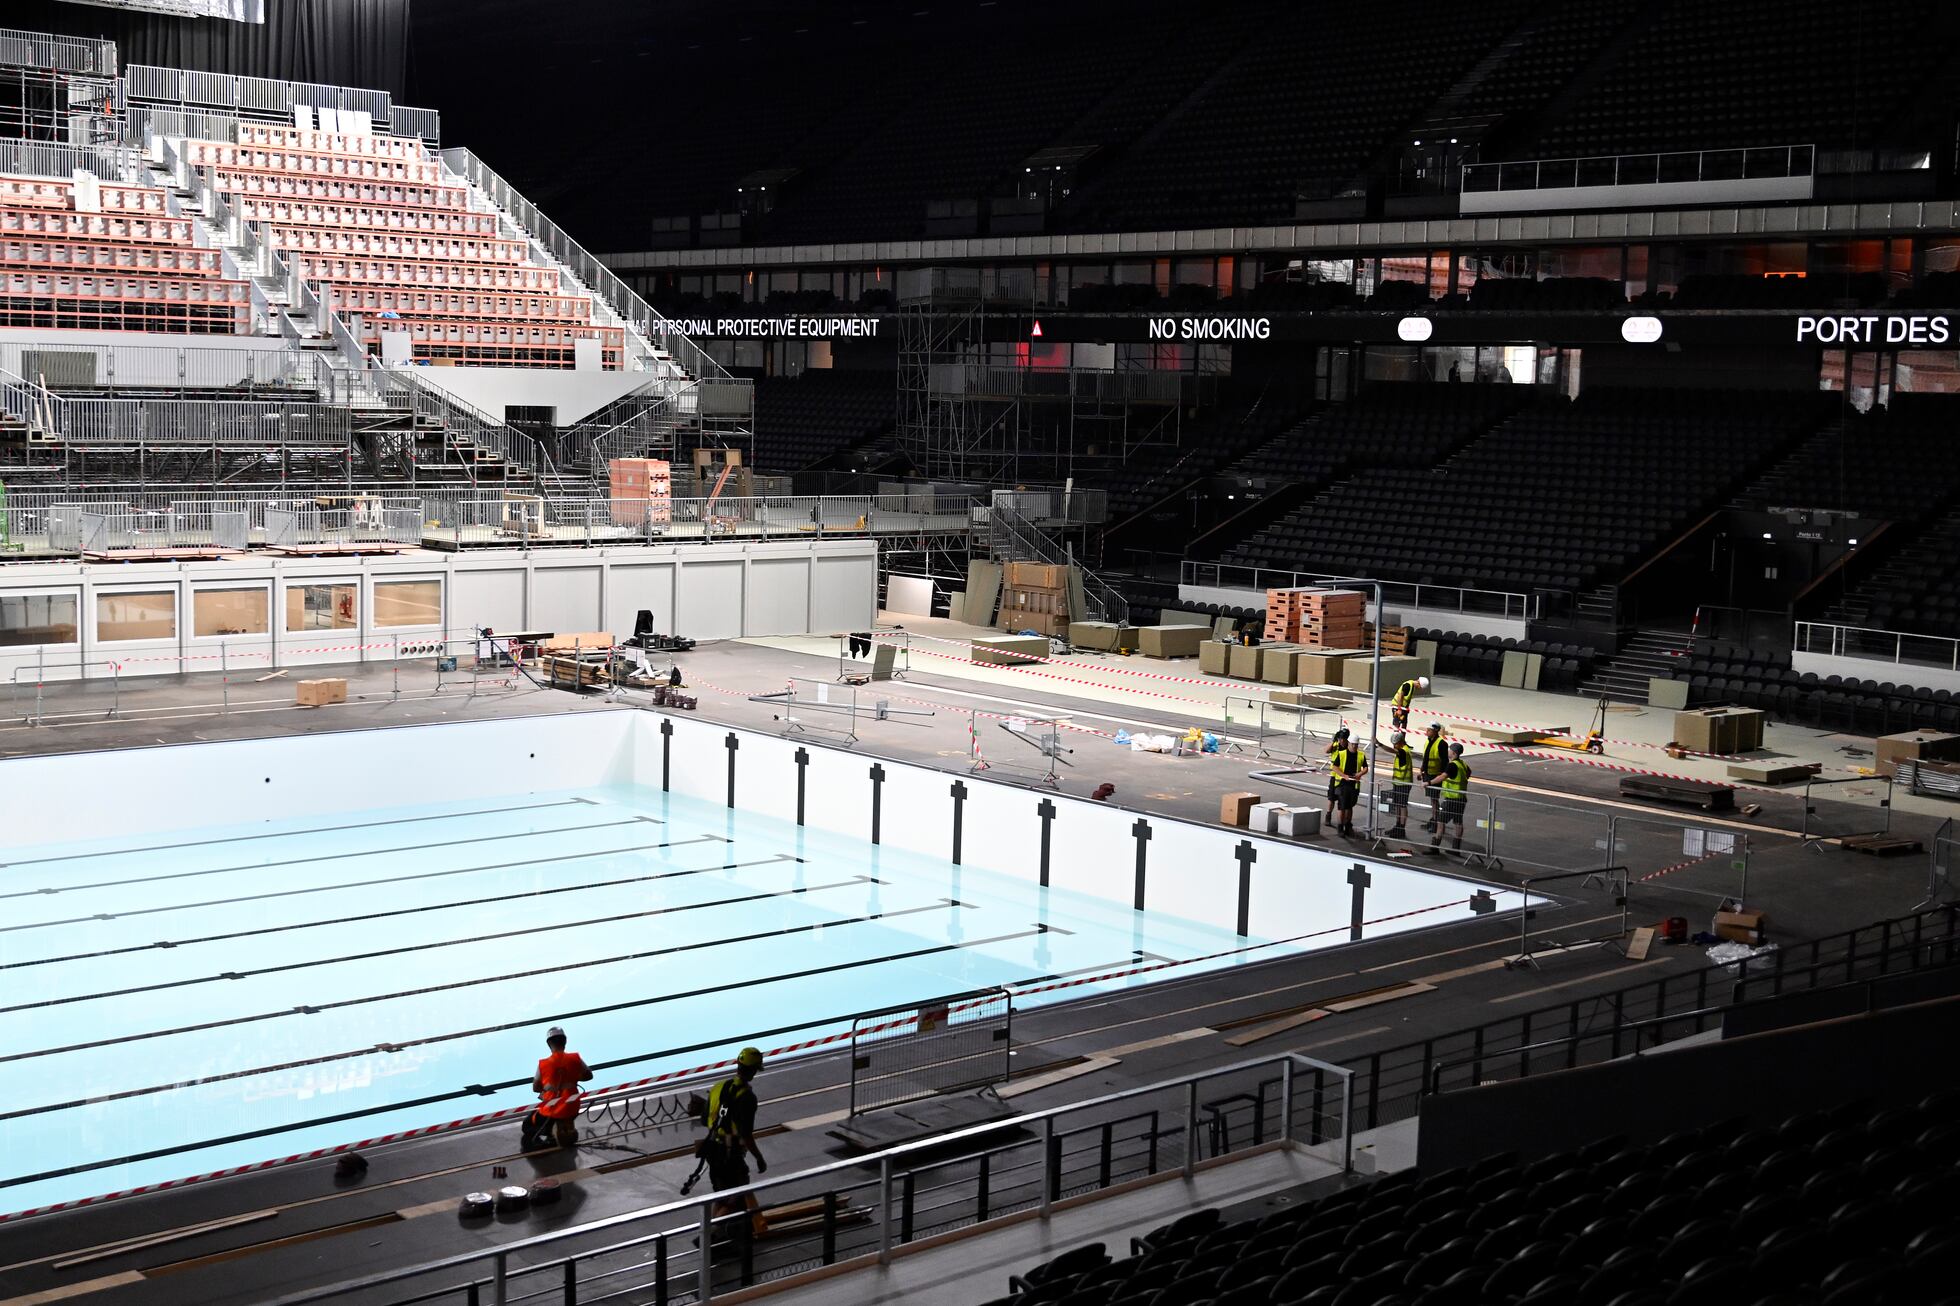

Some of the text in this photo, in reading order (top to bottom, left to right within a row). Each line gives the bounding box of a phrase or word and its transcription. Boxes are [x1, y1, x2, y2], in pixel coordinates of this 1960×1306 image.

[718, 319, 797, 336] PROTECTIVE
[799, 319, 880, 337] EQUIPMENT
[1149, 318, 1270, 339] NO SMOKING
[1797, 317, 1949, 342] PORT DES
